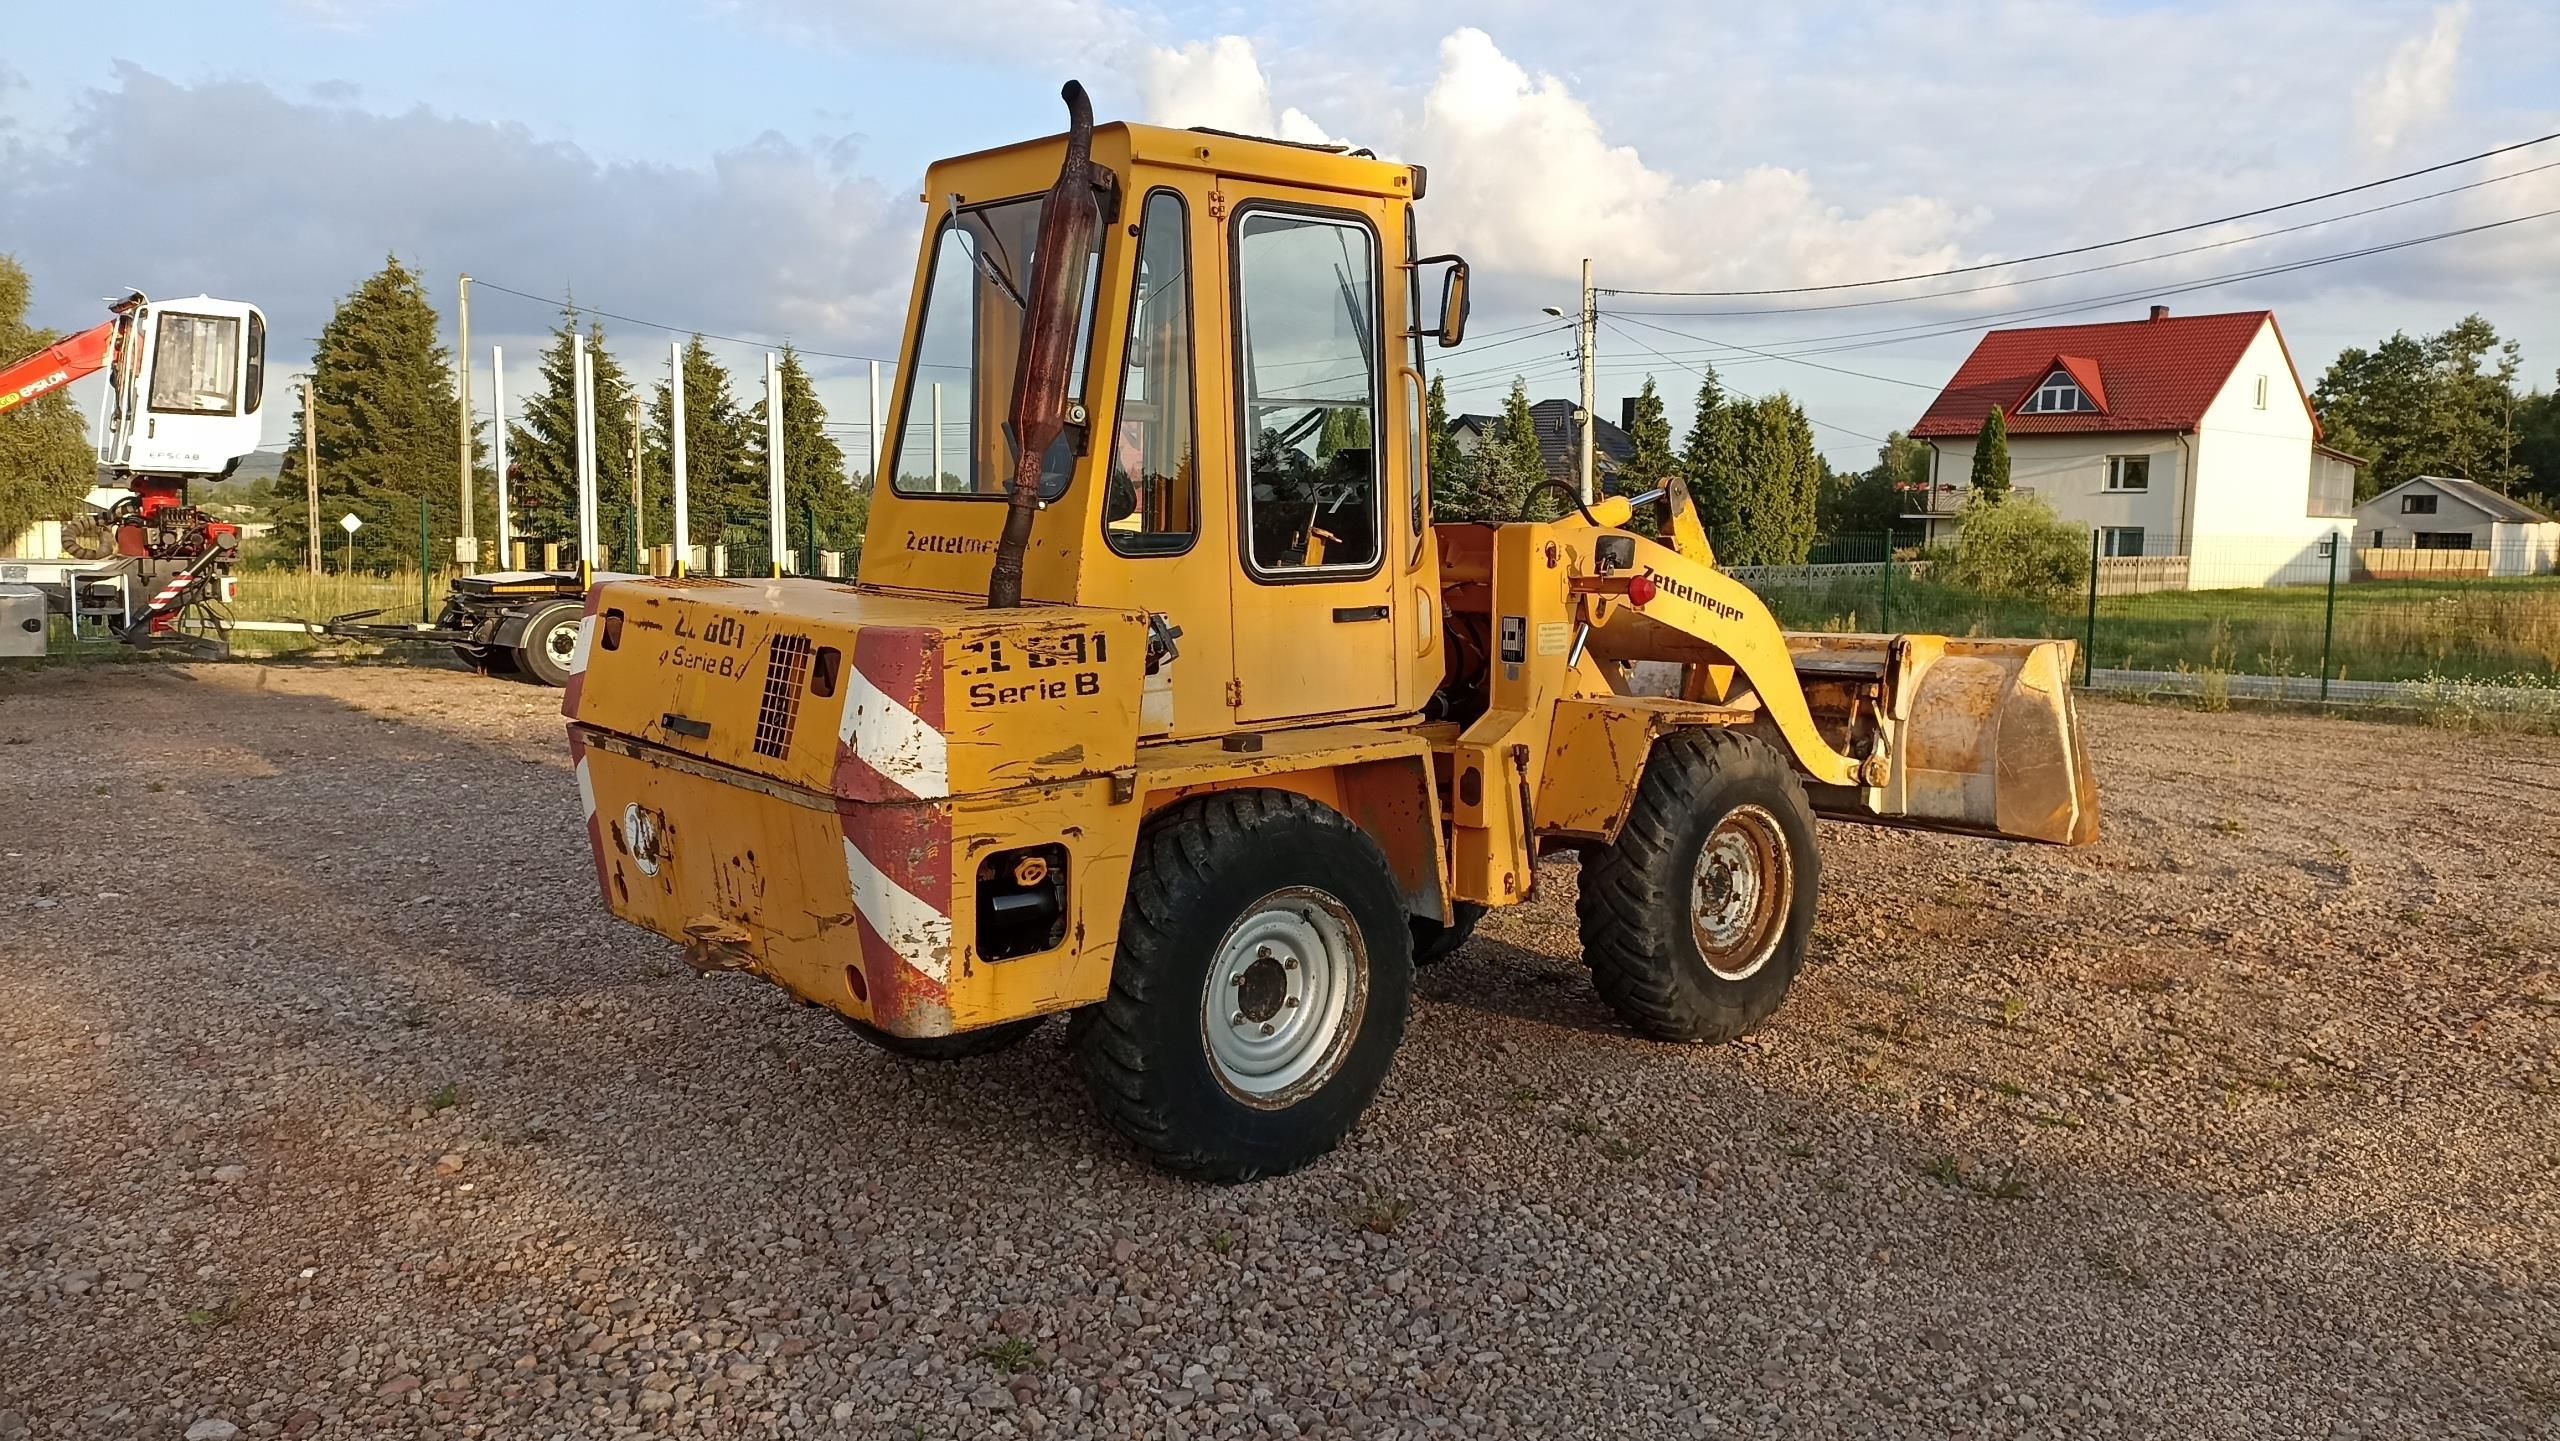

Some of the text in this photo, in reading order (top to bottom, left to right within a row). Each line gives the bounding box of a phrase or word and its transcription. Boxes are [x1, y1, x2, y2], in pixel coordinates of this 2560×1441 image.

[20, 370, 68, 398] EPSILON
[1643, 564, 1744, 621] Zettelmeyer
[672, 645, 734, 677] Serie B
[969, 671, 1100, 708] Serie B
